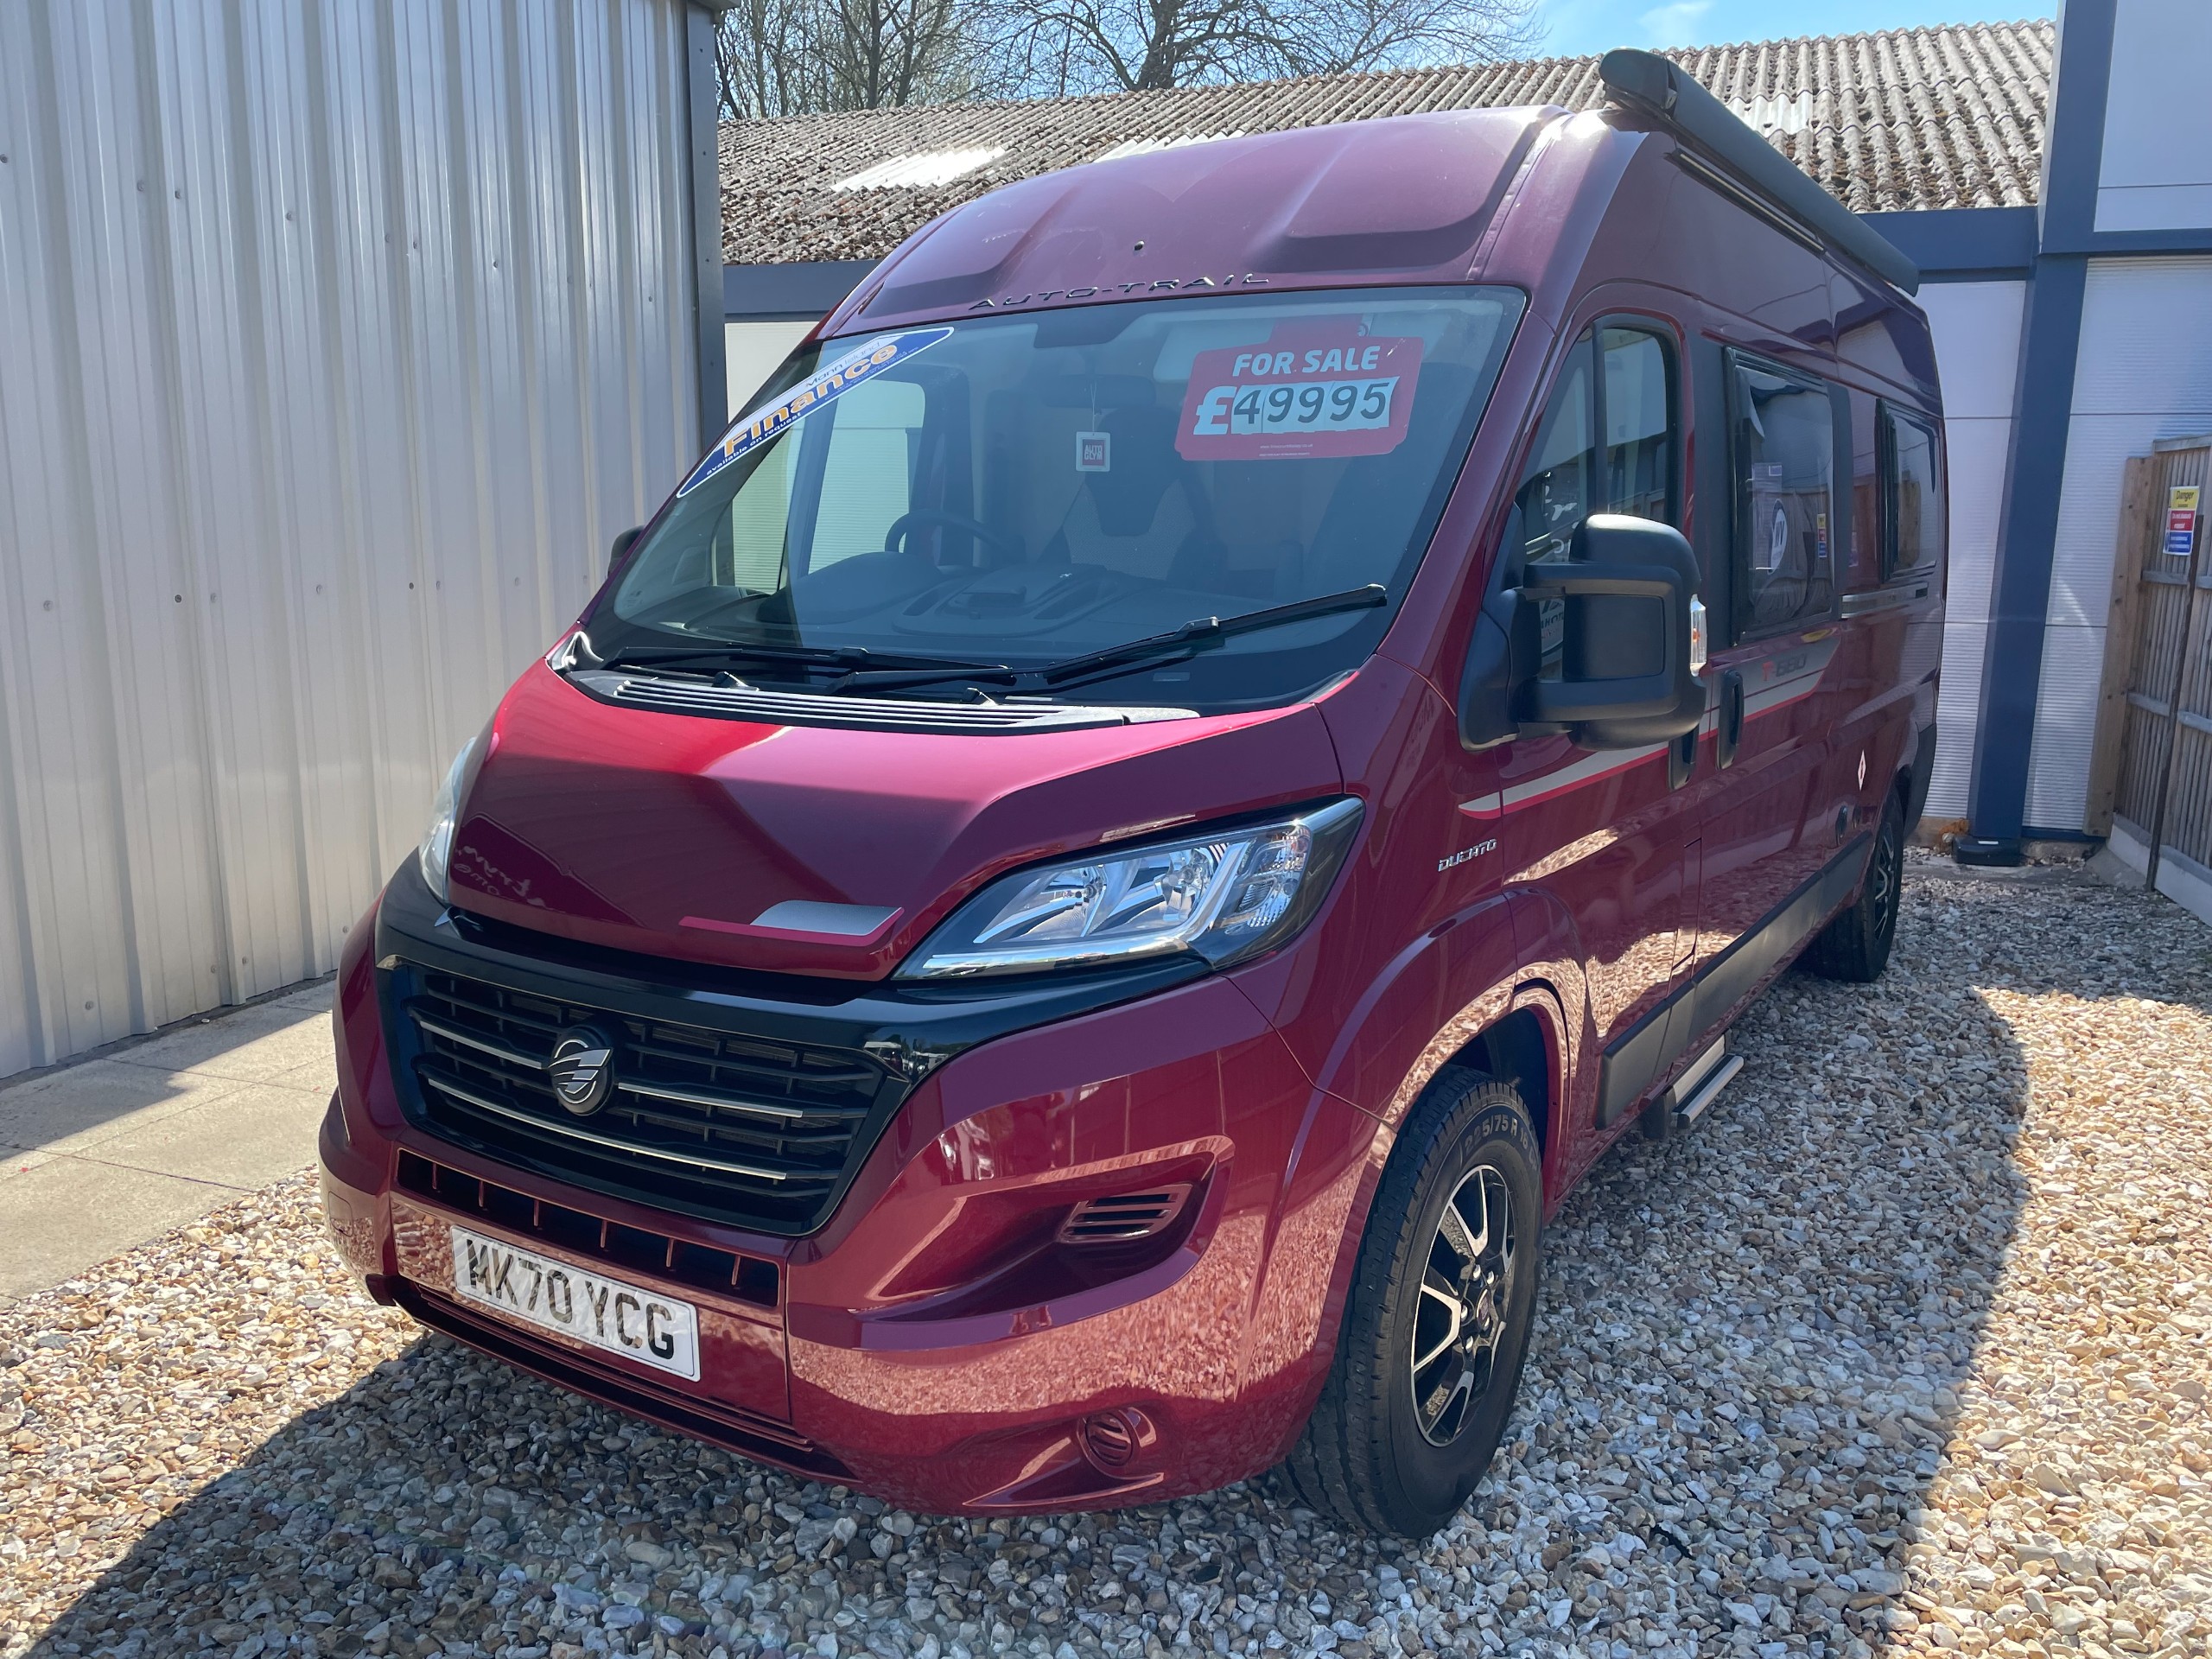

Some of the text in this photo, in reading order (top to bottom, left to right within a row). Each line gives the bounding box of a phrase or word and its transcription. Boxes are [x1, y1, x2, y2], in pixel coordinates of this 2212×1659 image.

[969, 273, 1269, 310] AUTO-TRAIL
[805, 364, 842, 387] Mann
[1232, 346, 1381, 377] FOR SALE
[724, 344, 898, 458] Finance
[1193, 380, 1390, 435] £49995
[706, 412, 802, 475] available on request
[1084, 444, 1103, 453] AUTO
[1438, 838, 1497, 872] DUCATO
[585, 1281, 674, 1360] YCG
